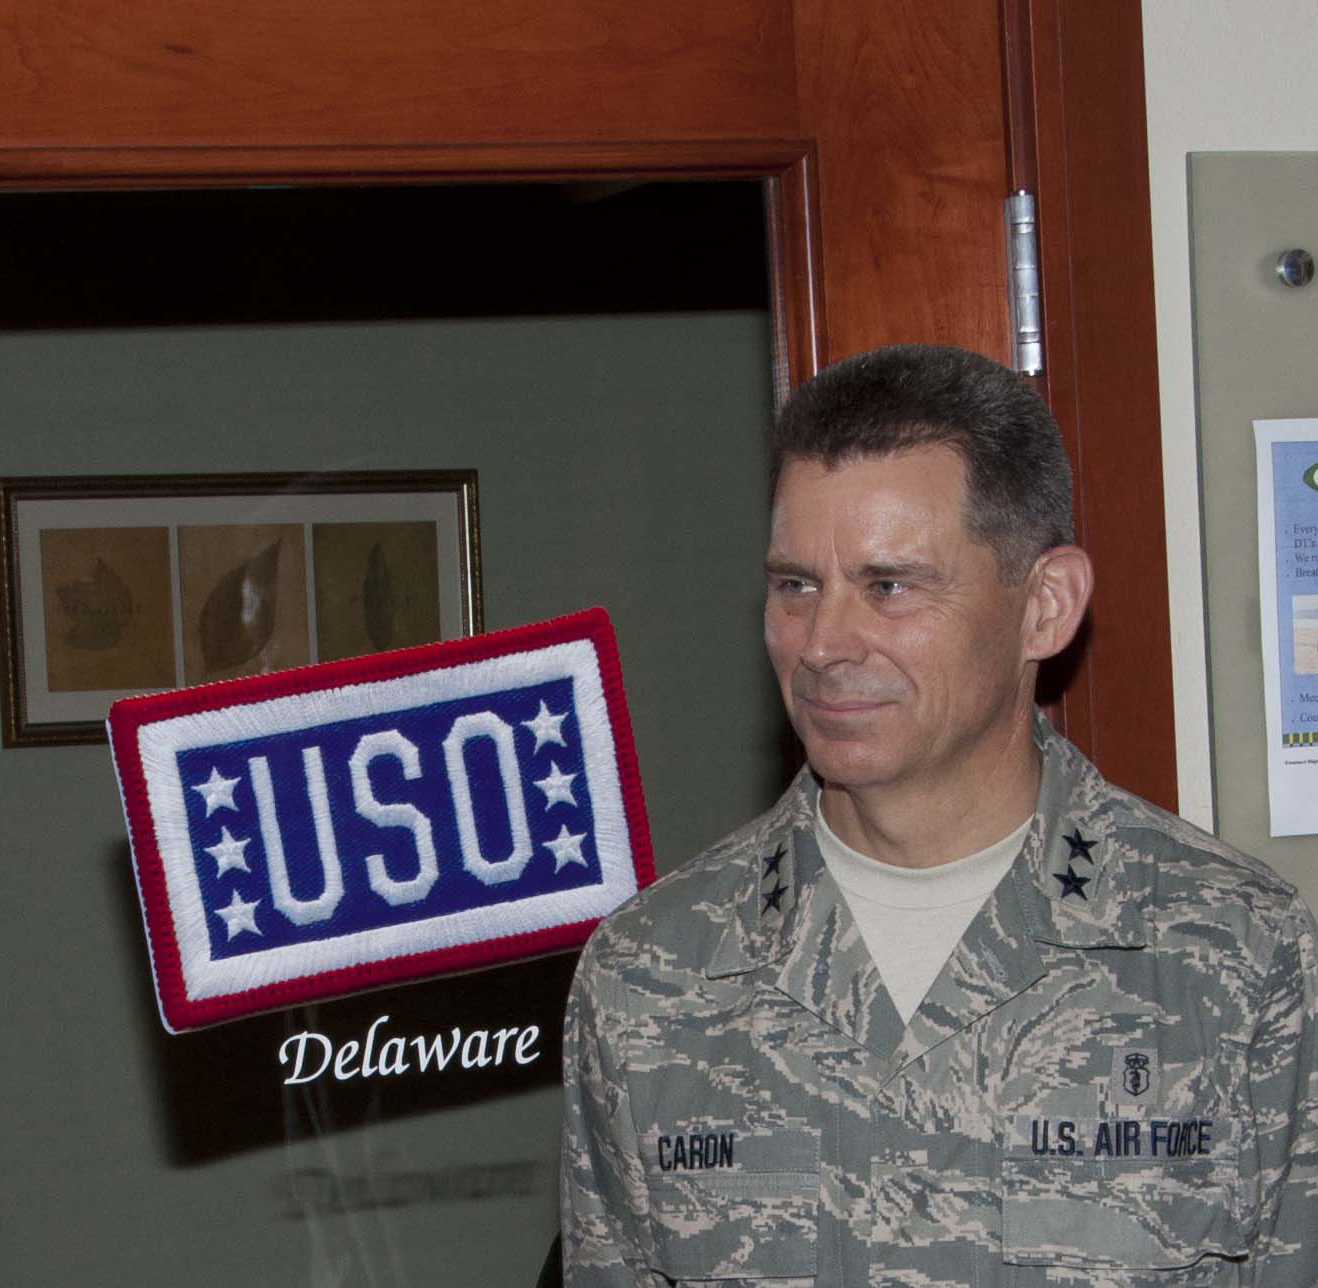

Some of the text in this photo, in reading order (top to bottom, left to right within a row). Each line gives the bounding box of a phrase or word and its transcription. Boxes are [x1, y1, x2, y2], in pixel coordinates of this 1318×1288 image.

[1293, 523, 1318, 536] Every
[1294, 553, 1309, 564] We
[247, 710, 534, 926] USO
[278, 1015, 542, 1086] Delaware
[656, 1132, 735, 1173] CARON
[1029, 1117, 1213, 1158] U.S. AIR FORCE
